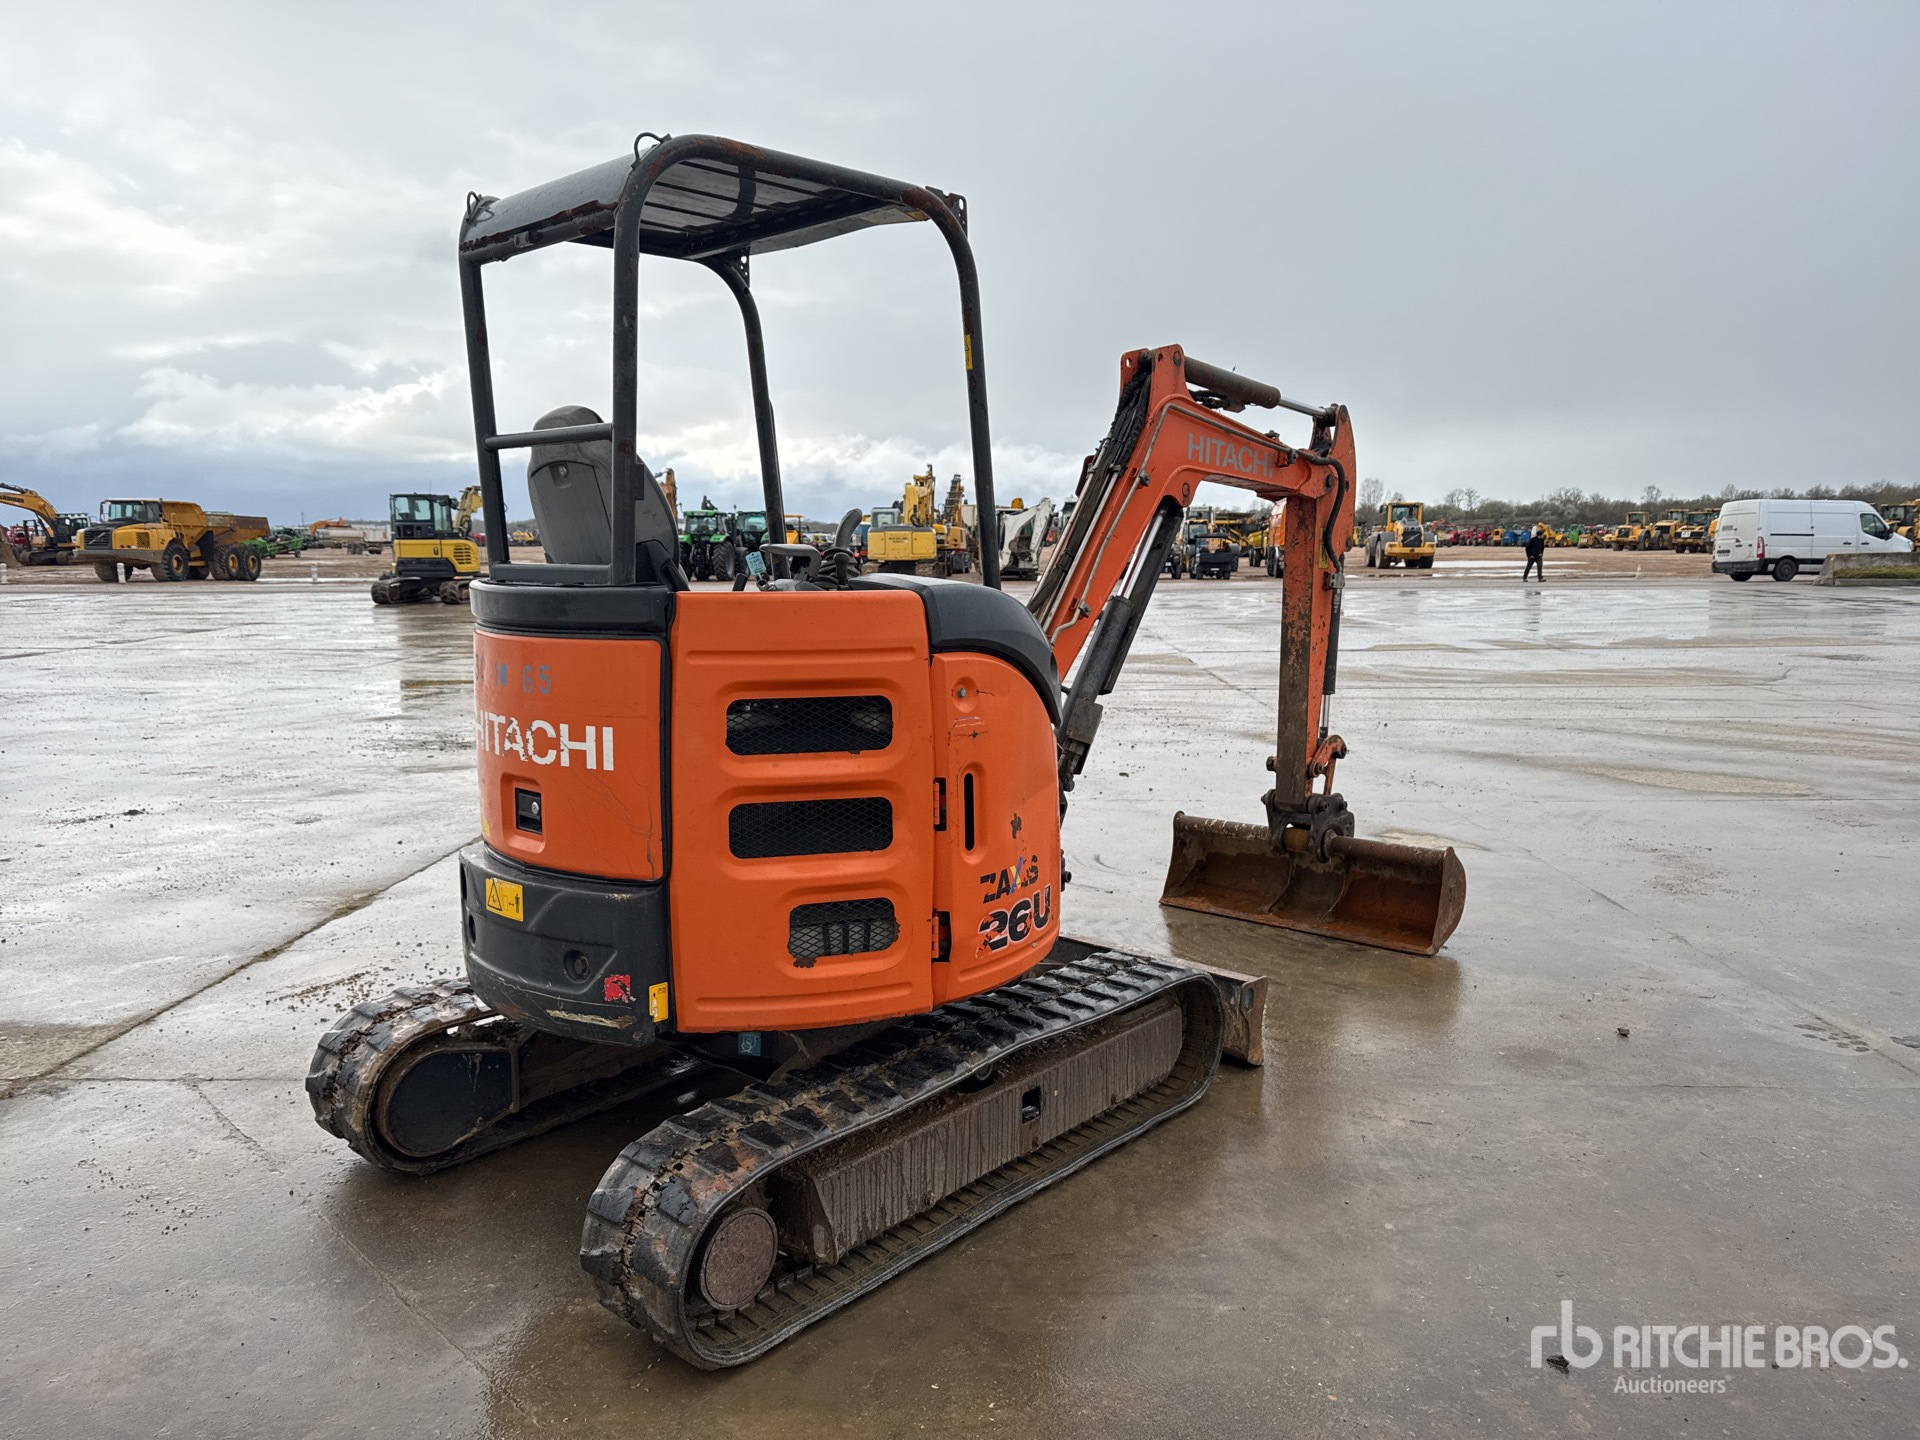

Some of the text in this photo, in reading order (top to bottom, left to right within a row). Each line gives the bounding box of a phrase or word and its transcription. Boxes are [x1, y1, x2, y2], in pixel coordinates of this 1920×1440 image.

[1187, 432, 1274, 478] HITACHI
[475, 709, 614, 771] HITACHI
[977, 884, 1051, 956] 26U
